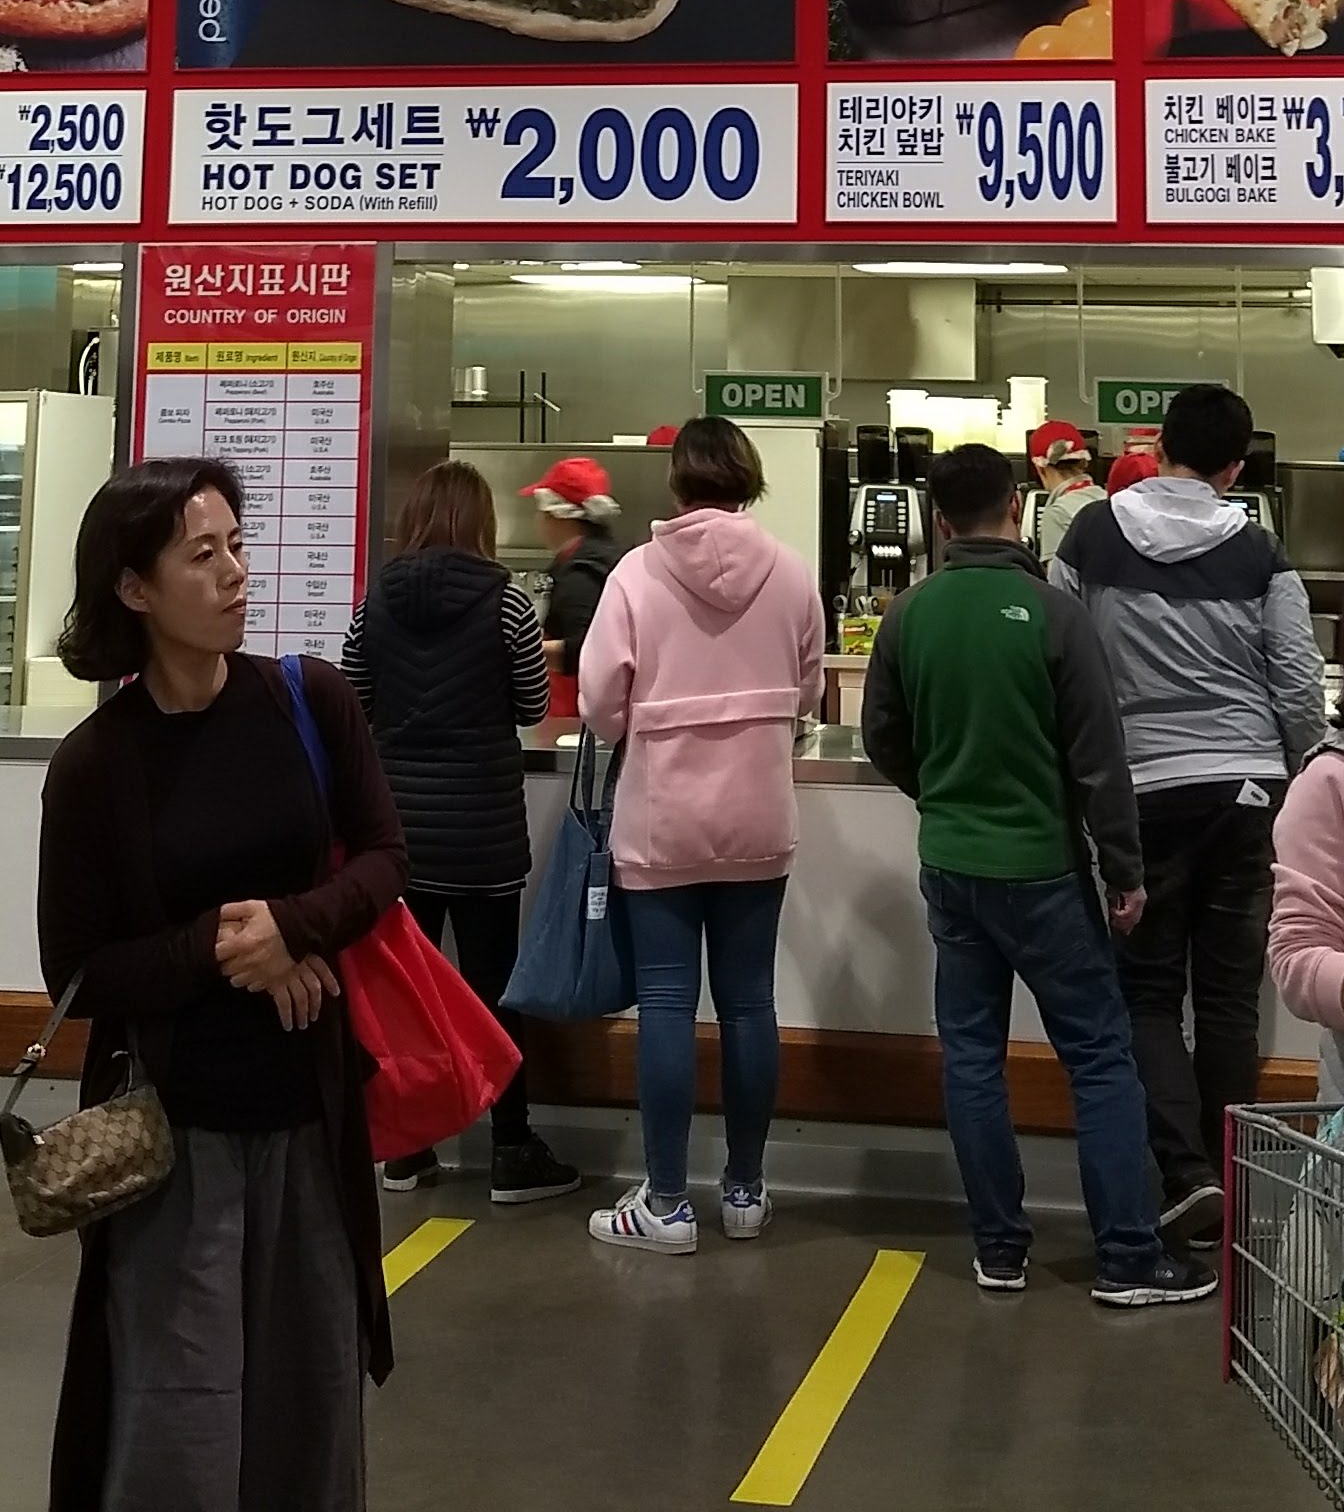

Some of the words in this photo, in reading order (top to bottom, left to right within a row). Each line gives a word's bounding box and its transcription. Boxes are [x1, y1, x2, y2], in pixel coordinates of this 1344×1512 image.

[839, 96, 942, 124] 테리야키
[1164, 95, 1203, 125] 치킨
[1216, 94, 1277, 125] 베이크
[204, 102, 444, 150] 핫도그세트
[1164, 128, 1228, 143] CHICKEN
[1235, 128, 1275, 142] BAKE
[838, 128, 885, 156] 치킨
[897, 128, 944, 155] 덮밥
[203, 163, 274, 190] HOT
[290, 163, 362, 190] DOG
[375, 162, 441, 190] SET
[837, 170, 899, 186] TERIYAKI
[1164, 154, 1215, 184] 불고기
[1225, 154, 1277, 184] 베이크
[201, 196, 239, 211] HOT
[244, 196, 283, 210] DOG
[304, 195, 355, 210] SODA
[359, 194, 394, 211] (With
[398, 194, 438, 211] Refill)
[837, 191, 898, 208] CHICKEN
[903, 191, 944, 208] BOWL
[1166, 187, 1230, 202] BULGOGI
[1237, 187, 1277, 202] BAKE
[163, 263, 351, 297] 원산지표시판
[164, 309, 246, 325] COUNTRY
[254, 309, 278, 324] OF
[287, 308, 346, 324] ORIGIN
[721, 383, 806, 409] OPEN
